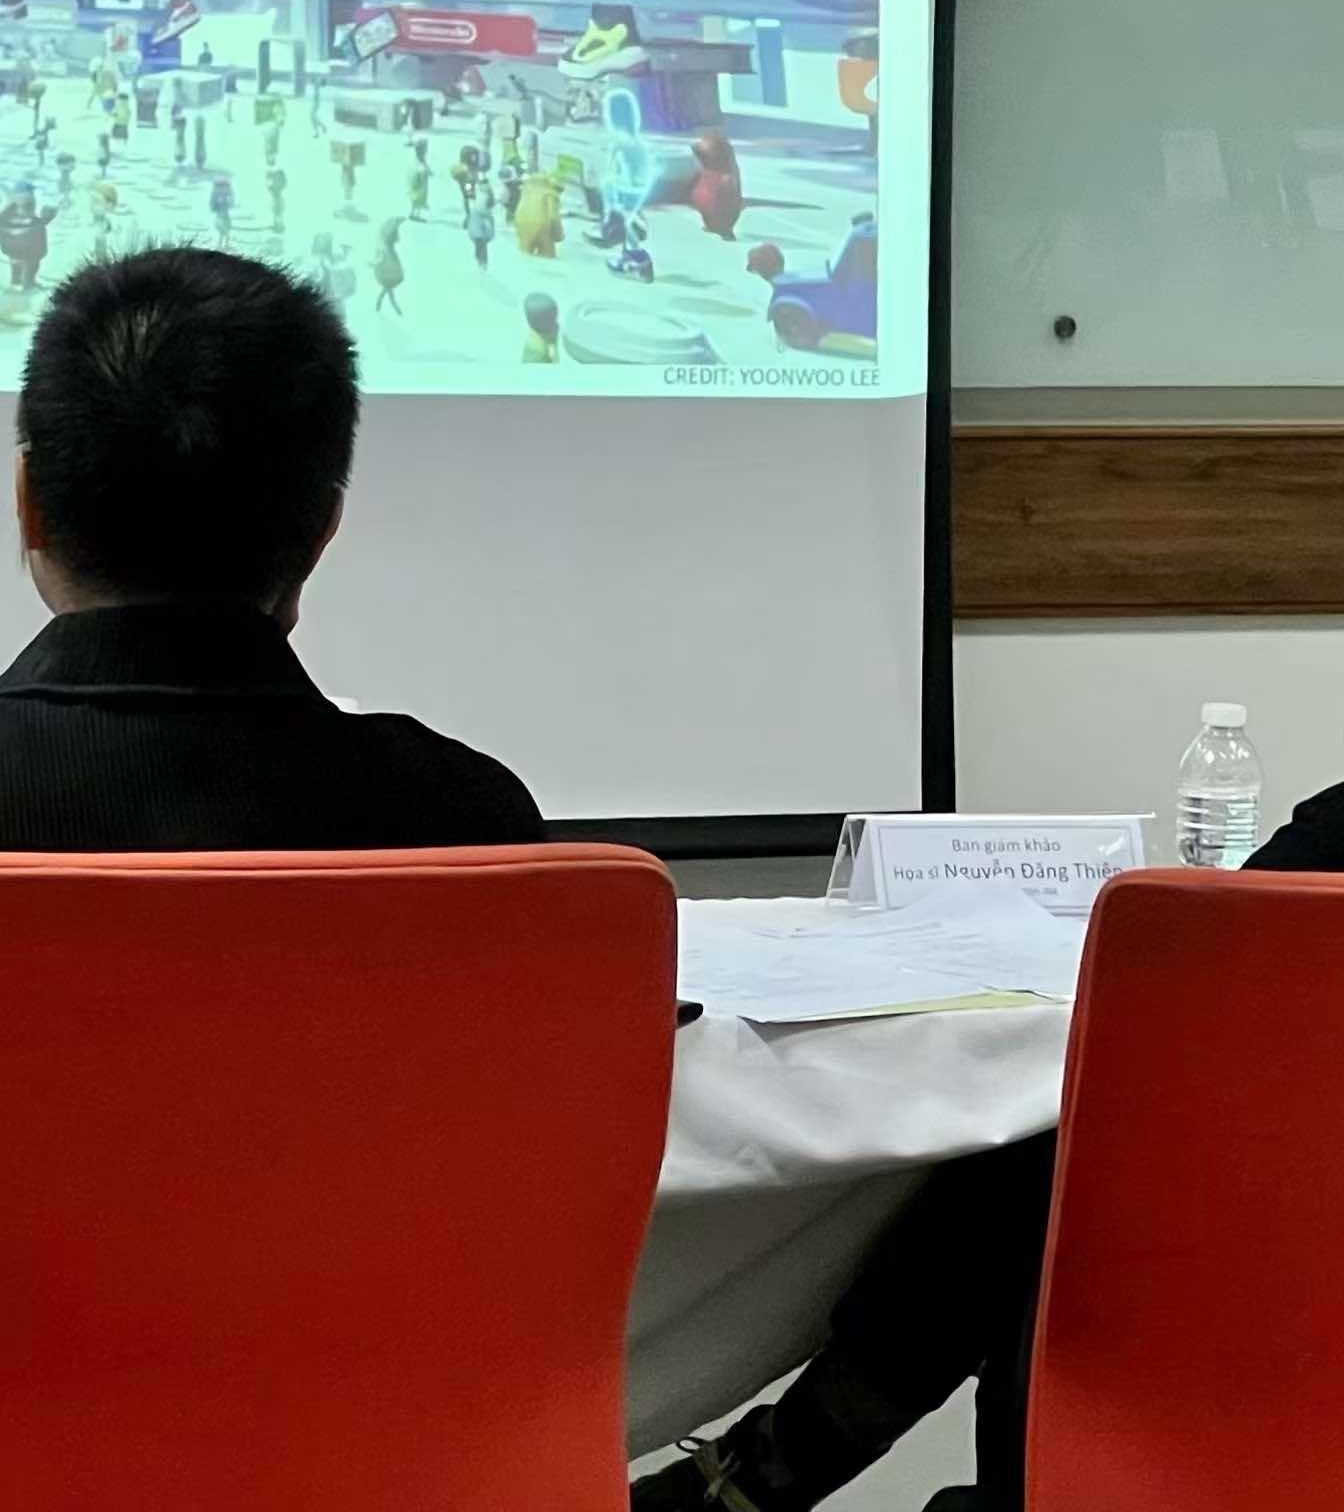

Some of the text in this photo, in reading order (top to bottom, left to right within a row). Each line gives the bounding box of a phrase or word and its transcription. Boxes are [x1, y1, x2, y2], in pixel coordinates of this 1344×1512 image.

[663, 366, 881, 387] CREDIT: YOONWOO LEE
[951, 839, 981, 852] Ban
